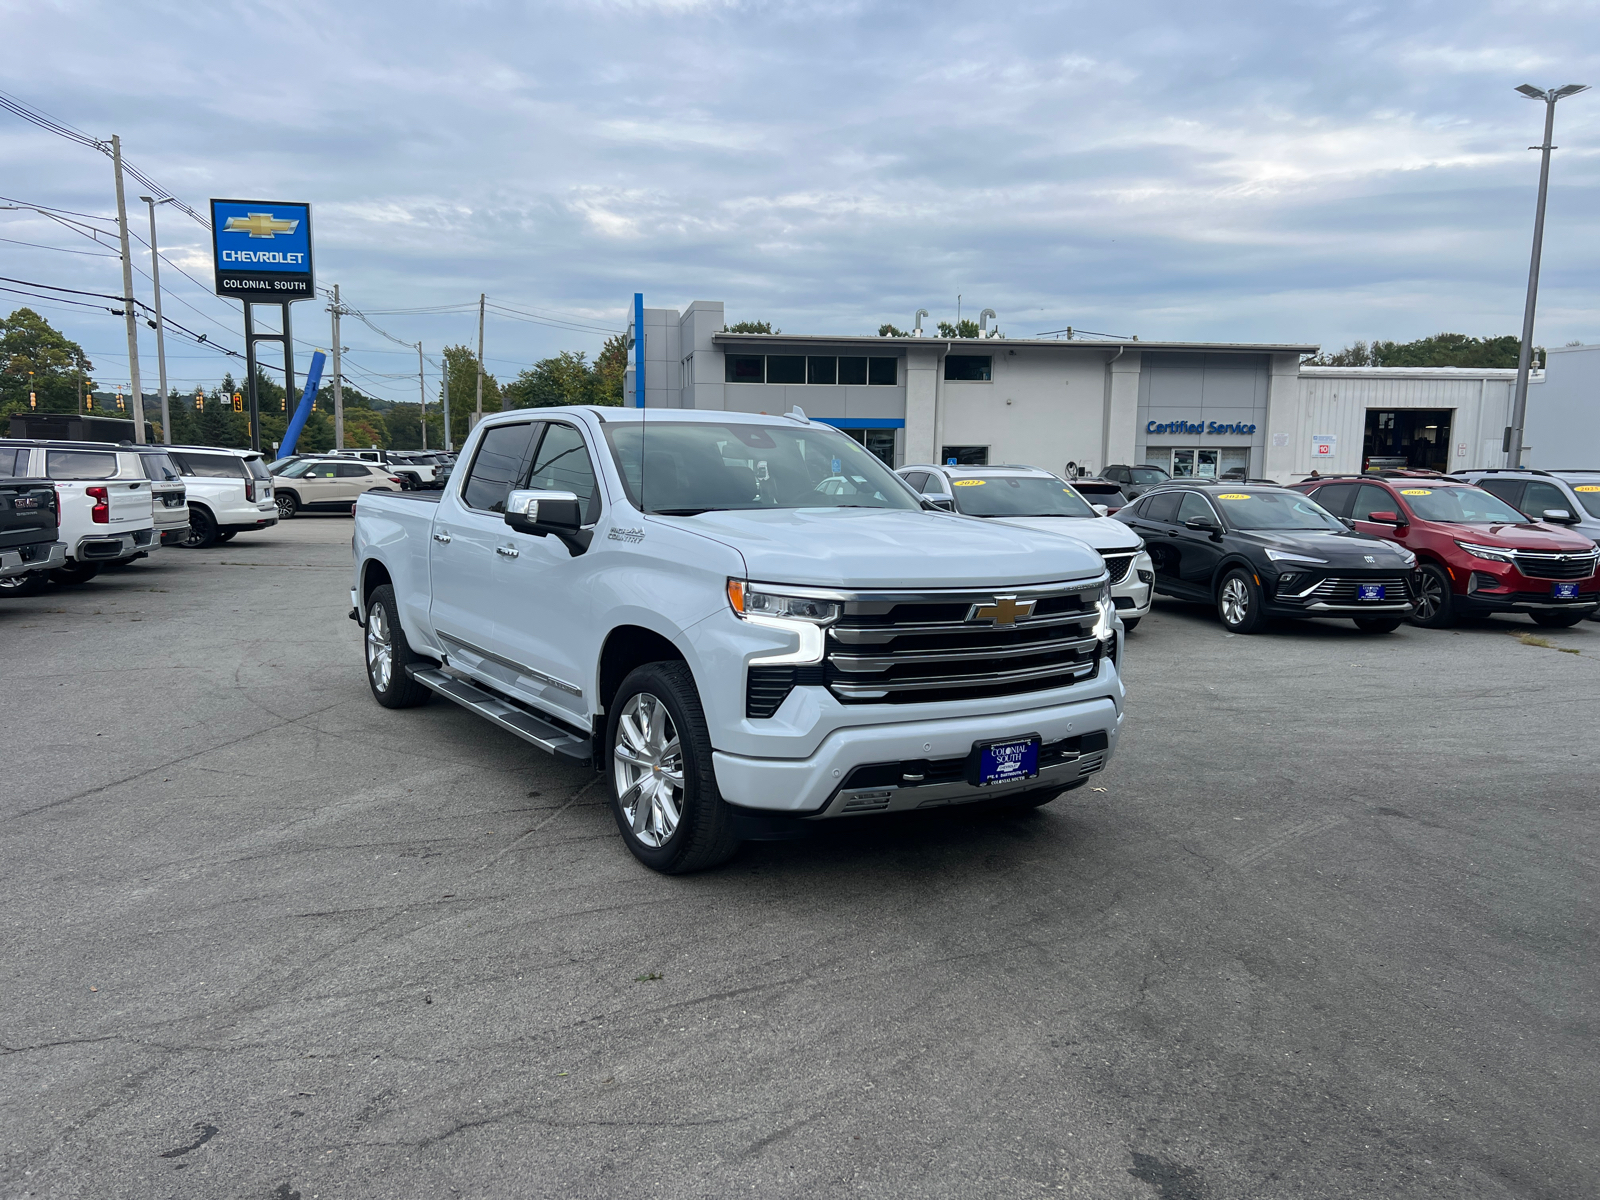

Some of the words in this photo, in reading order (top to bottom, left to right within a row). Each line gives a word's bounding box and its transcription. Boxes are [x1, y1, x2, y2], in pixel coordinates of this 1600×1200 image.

[222, 250, 304, 264] CHEVROLET
[223, 279, 272, 289] COLONIAL
[274, 281, 306, 290] SOUTH
[1147, 420, 1205, 433] Certified
[1209, 421, 1256, 434] Service
[607, 533, 644, 545] COUNTRY
[991, 745, 1028, 757] COLONIAL
[996, 753, 1022, 764] SOUTH
